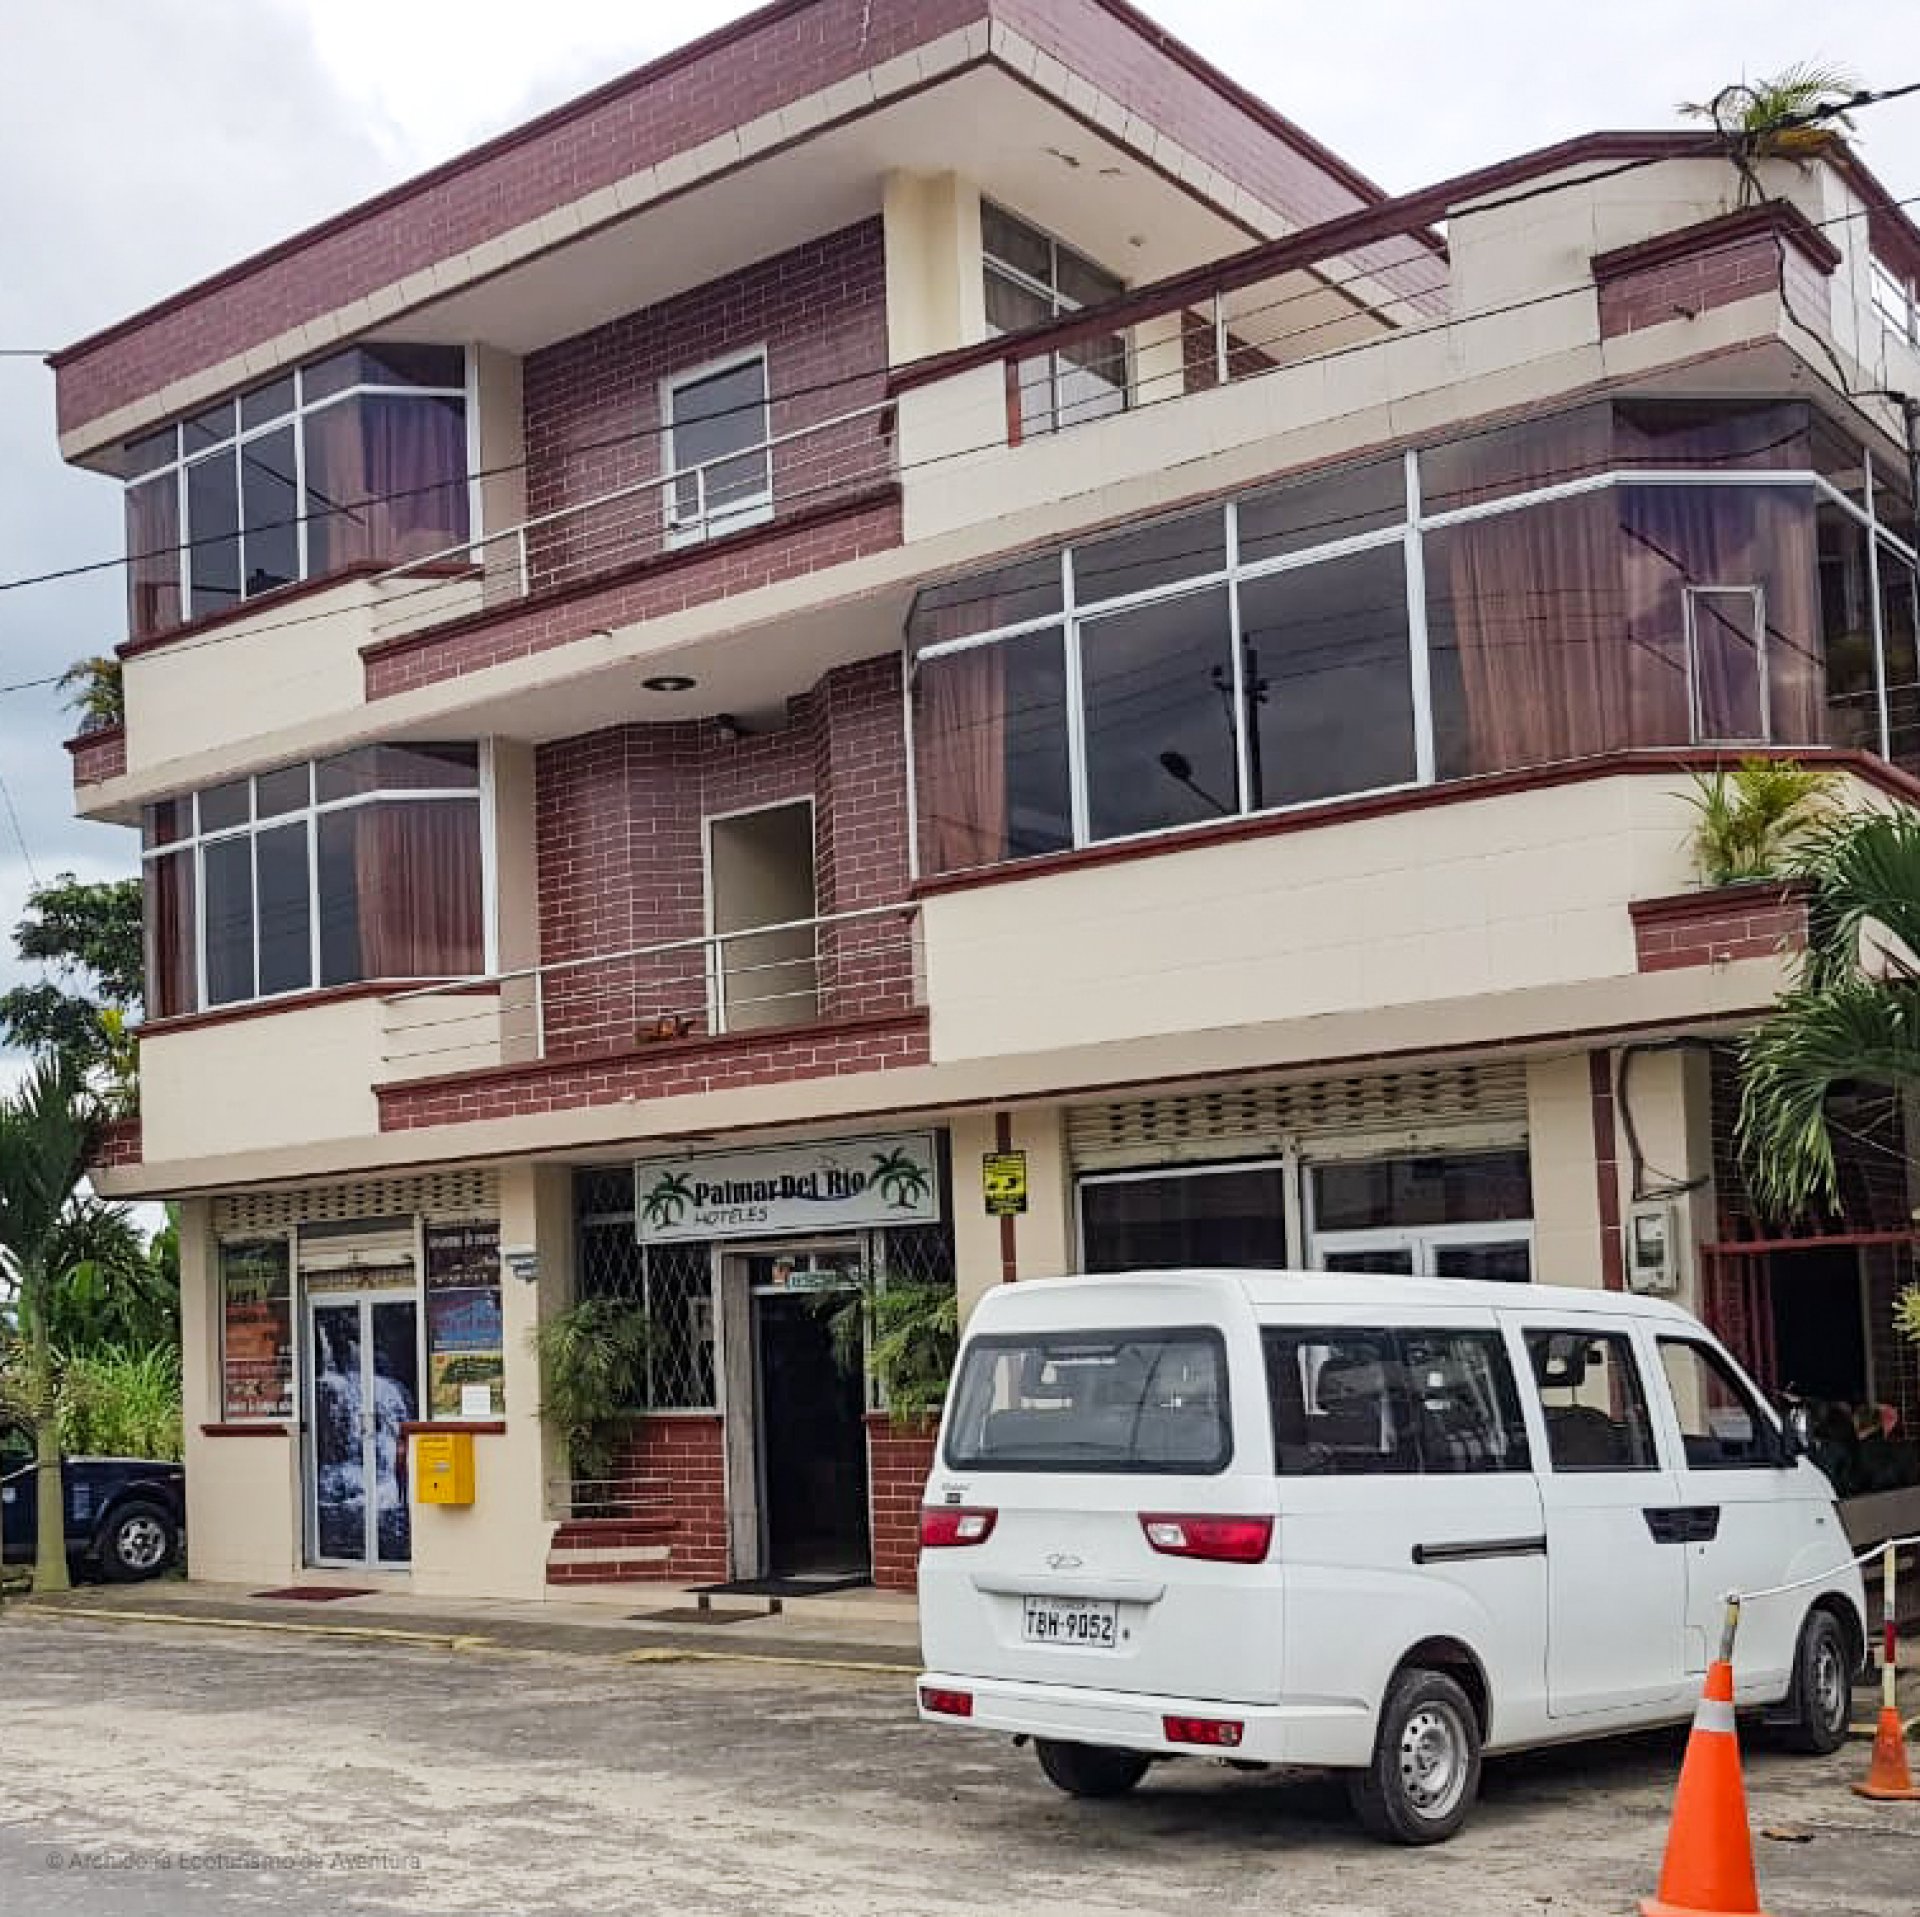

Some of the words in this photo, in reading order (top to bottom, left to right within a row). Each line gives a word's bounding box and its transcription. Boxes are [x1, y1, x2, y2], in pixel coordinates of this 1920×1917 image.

[693, 1180, 777, 1206] Palmar
[781, 1172, 818, 1200] Del
[695, 1206, 768, 1225] HOTELES
